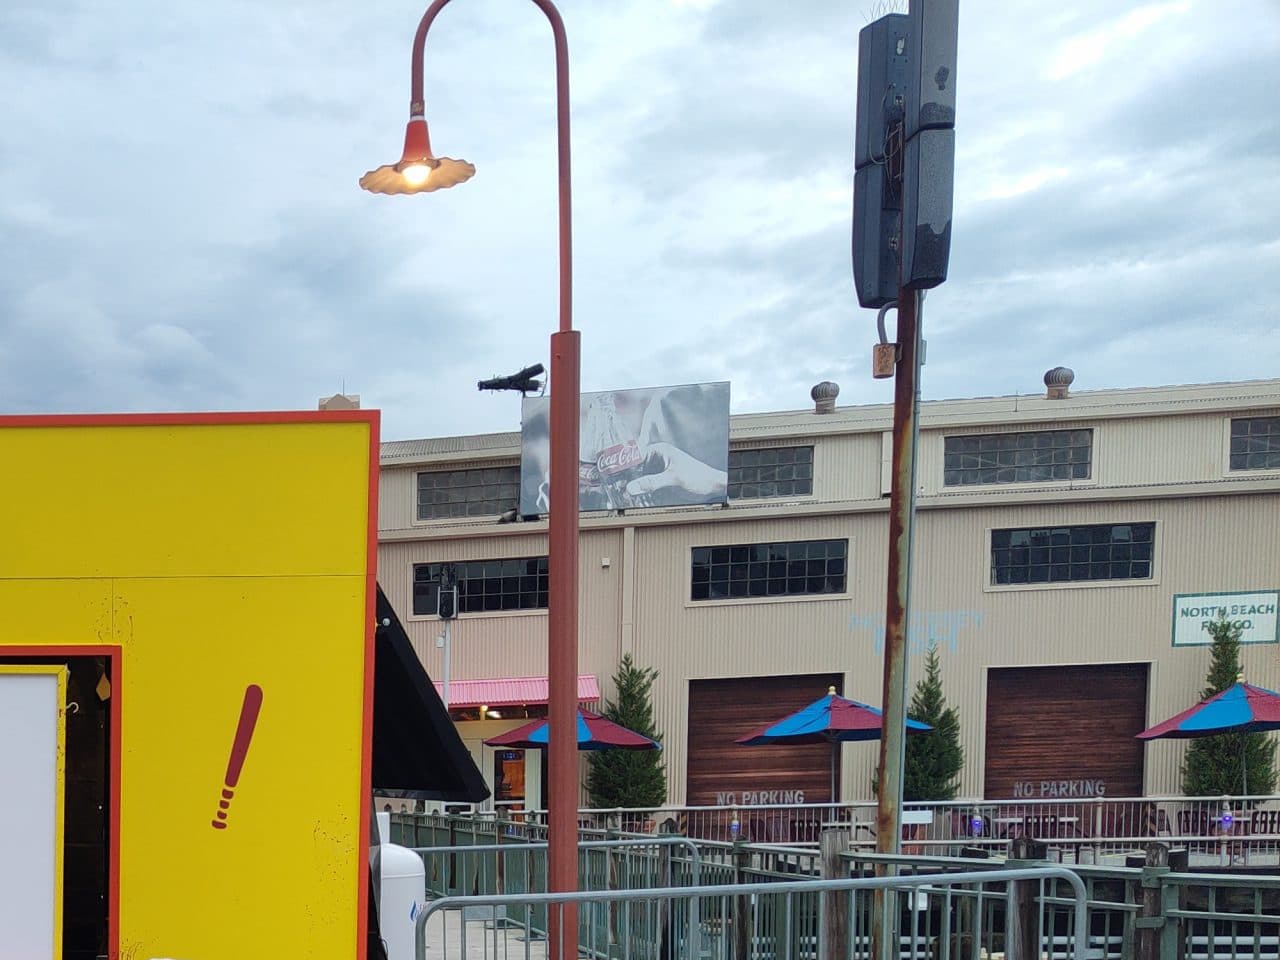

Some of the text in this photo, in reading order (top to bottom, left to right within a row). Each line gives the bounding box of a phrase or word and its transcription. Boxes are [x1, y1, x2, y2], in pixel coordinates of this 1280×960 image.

[1181, 604, 1275, 618] NORTH BEACH
[1014, 779, 1106, 798] NO PARKING
[716, 789, 805, 806] NO PARKING
